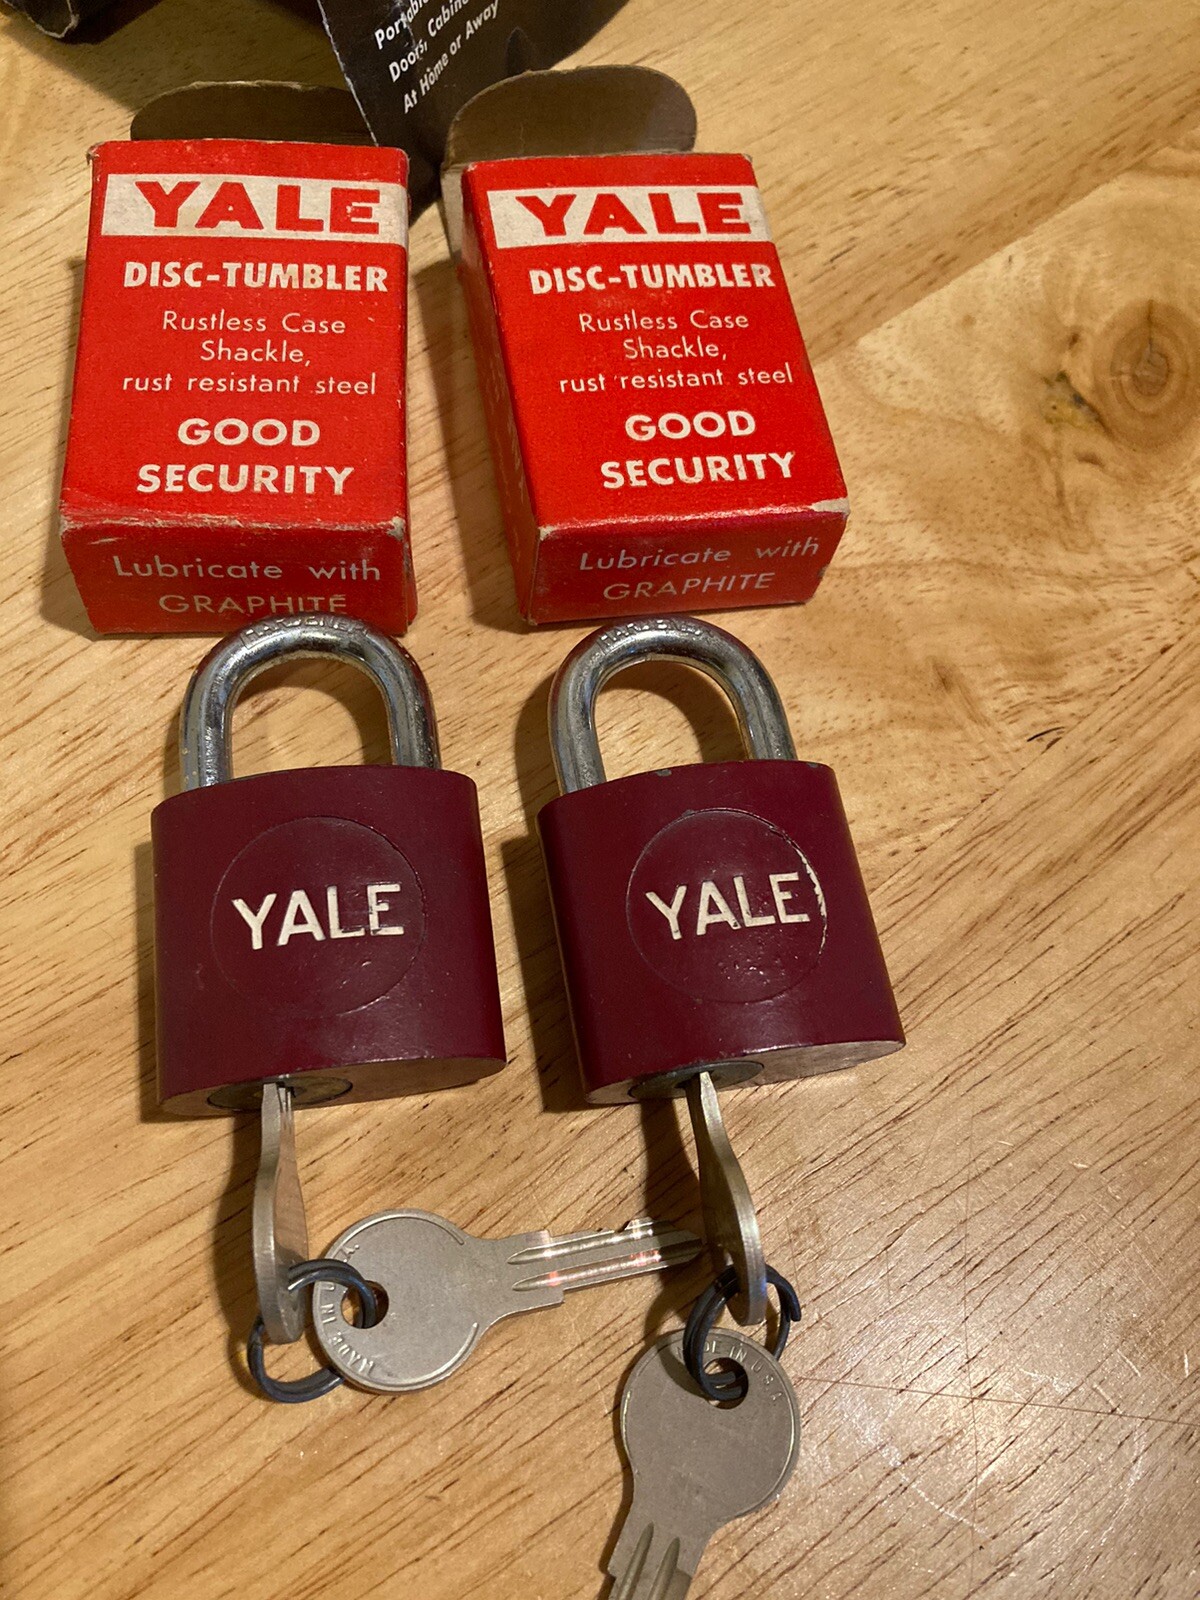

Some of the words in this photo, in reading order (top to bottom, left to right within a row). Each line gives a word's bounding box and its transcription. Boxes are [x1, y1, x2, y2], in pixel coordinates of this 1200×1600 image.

[374, 0, 430, 50] Portabl
[388, 39, 428, 82] Doors,
[403, 91, 418, 114] At
[420, 54, 449, 97] Home
[449, 35, 462, 56] or
[465, 0, 499, 40] Away
[135, 181, 381, 235] YALE
[515, 192, 752, 237] YALE
[123, 261, 390, 293] DISC-TUMBLER
[529, 262, 777, 295] DISC-TUMBLER
[163, 308, 267, 333] Rustless
[282, 312, 347, 335] Case
[579, 308, 678, 333] Rustless
[689, 310, 750, 331] Case
[200, 339, 311, 367] Shackle,
[622, 335, 728, 362] Shackle,
[122, 373, 173, 392] rust
[187, 372, 299, 393] resistant
[315, 372, 377, 395] steel
[559, 373, 605, 393] rust
[619, 367, 724, 390] resistant
[738, 362, 794, 385] steel
[177, 417, 321, 447] GOOD
[625, 410, 757, 442] GOOD
[137, 463, 355, 496] SECURITY
[600, 450, 796, 490] SECURITY
[112, 555, 283, 580] Lubricate
[308, 558, 381, 581] with
[579, 547, 732, 572] Lubricate
[756, 536, 820, 559] with
[602, 572, 776, 601] GRAPHITE
[159, 594, 348, 615] GRAPHITE
[231, 883, 405, 950] YALE
[645, 871, 811, 940] YALE
[320, 1303, 337, 1324] IN
[327, 1331, 375, 1377] MADE
[728, 1344, 749, 1363] IN
